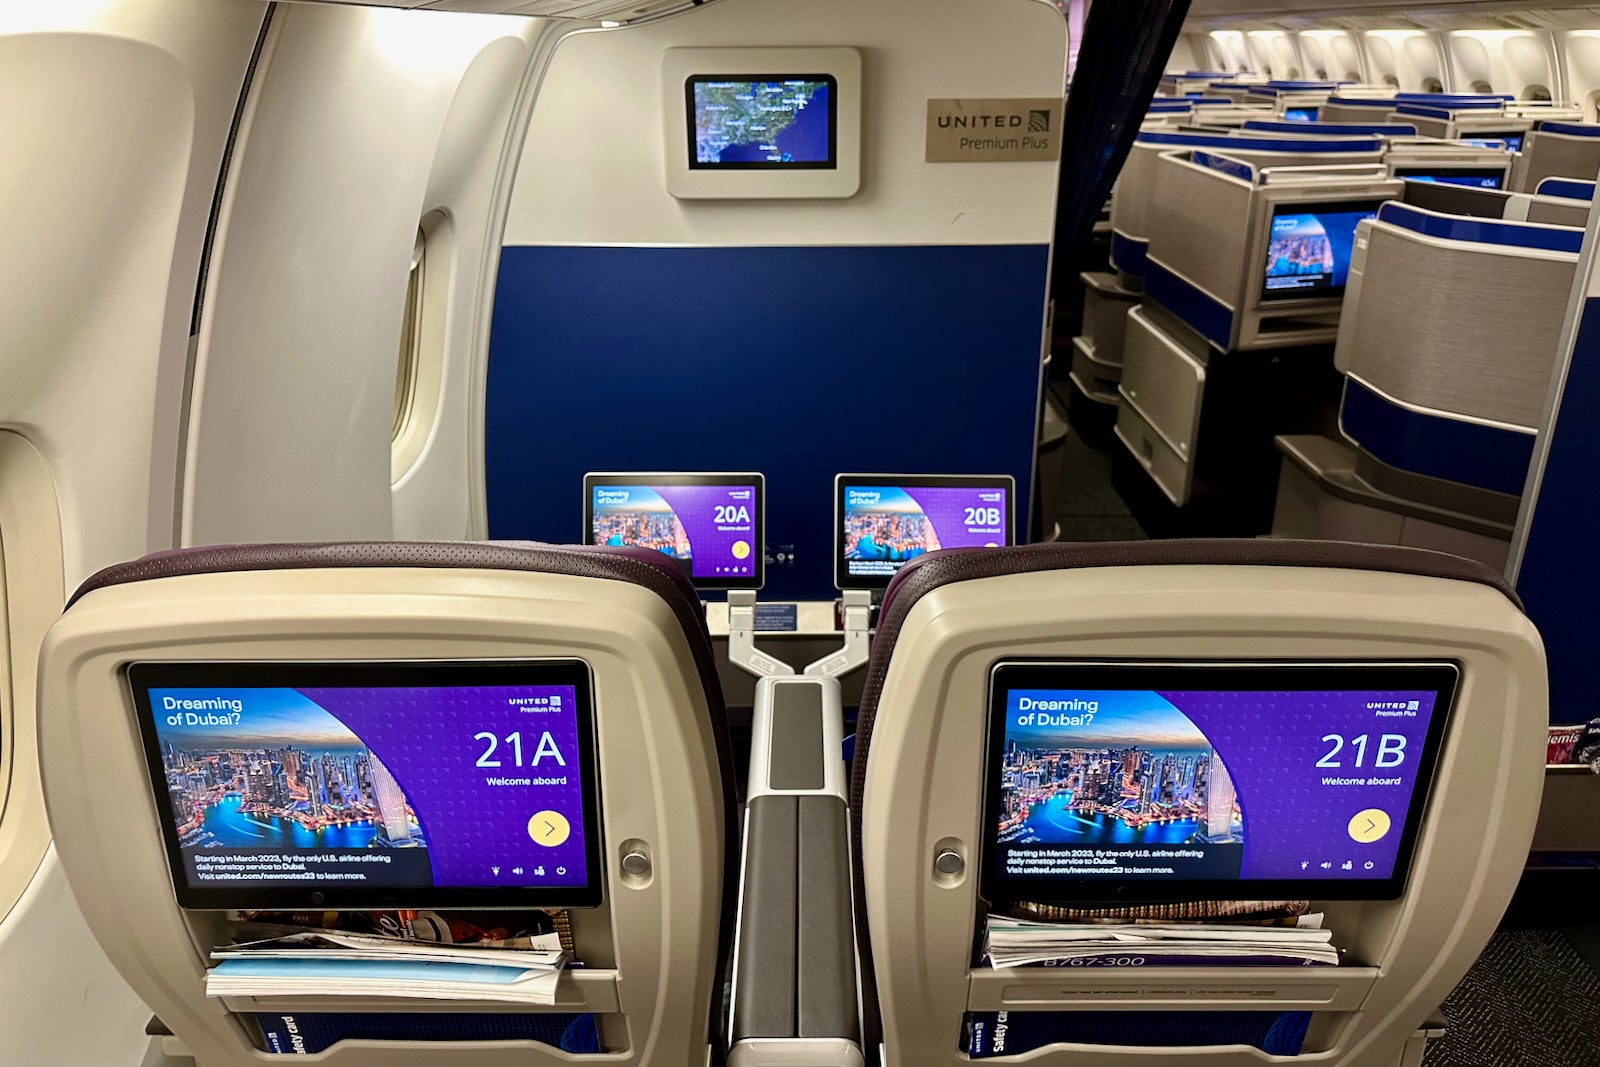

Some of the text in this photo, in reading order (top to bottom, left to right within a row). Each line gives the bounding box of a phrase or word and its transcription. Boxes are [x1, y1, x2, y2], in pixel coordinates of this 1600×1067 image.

[938, 116, 1021, 128] UNITED
[960, 137, 1048, 149] Premium Plus
[714, 505, 750, 523] 20A
[964, 508, 1000, 525] 20B
[163, 697, 242, 712] Dreaming
[1019, 698, 1098, 713] Dreaming
[167, 712, 240, 726] of Dubai?
[1018, 713, 1094, 726] of Dubai?
[474, 731, 566, 767] 21A
[1315, 734, 1407, 768] 21B
[486, 776, 567, 786] Welcome aboard
[1321, 777, 1401, 786] Welcome aboard
[194, 855, 225, 863] Starting
[258, 855, 282, 863] 2023,
[282, 855, 292, 863] fly
[306, 855, 322, 863] only
[361, 854, 391, 863] offering
[1007, 849, 1038, 858] Starting
[1071, 850, 1094, 858] 2023,
[1096, 850, 1105, 858] fly
[1120, 850, 1135, 858] only
[1175, 850, 1204, 858] offering
[198, 872, 215, 880] Visit
[215, 872, 315, 880] united.com/newroutes23
[325, 872, 344, 880] learn
[1006, 866, 1023, 874] Visit
[1024, 866, 1123, 874] united.com/newroutes23
[281, 1016, 298, 1033] card
[993, 1023, 1008, 1052] Safety
